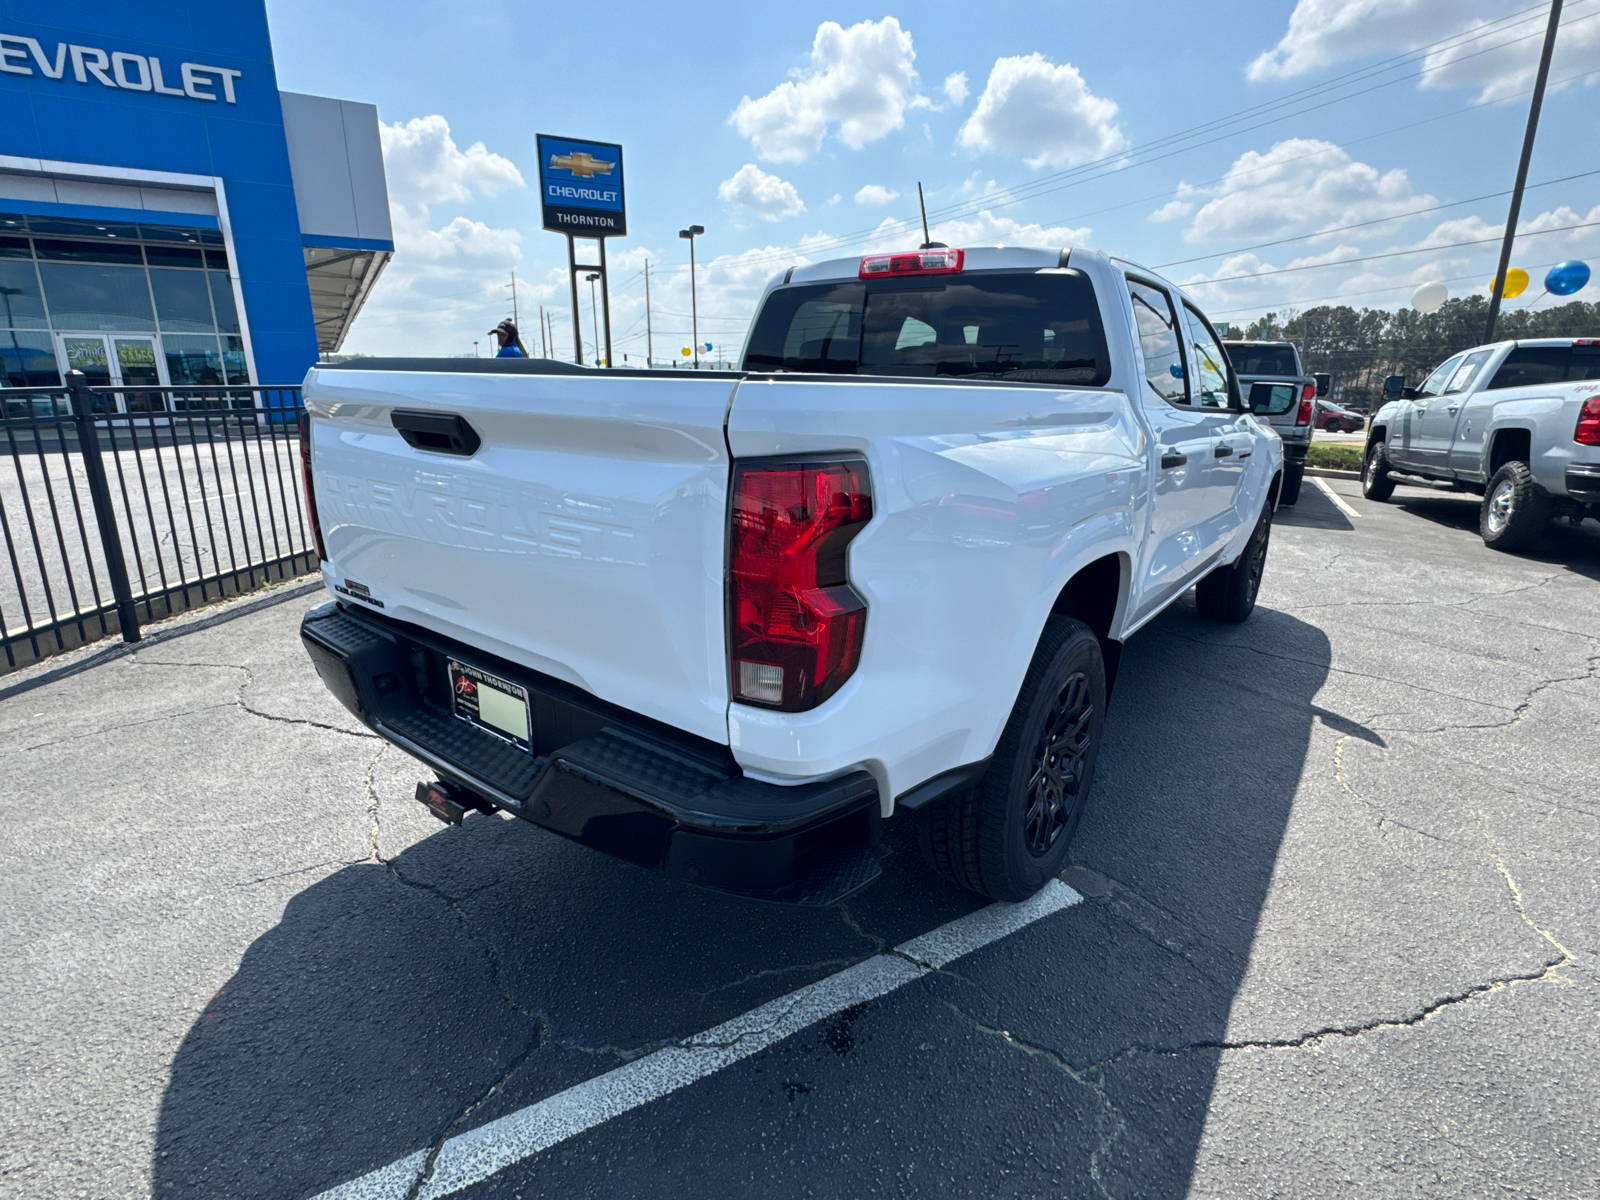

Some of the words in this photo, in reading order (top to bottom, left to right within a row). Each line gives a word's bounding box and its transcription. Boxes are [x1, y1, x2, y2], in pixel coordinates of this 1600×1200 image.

[549, 185, 618, 202] CHEVROLET
[557, 213, 614, 227] THORNTON
[464, 667, 483, 680] JOHN
[483, 675, 523, 697] THORNTON
